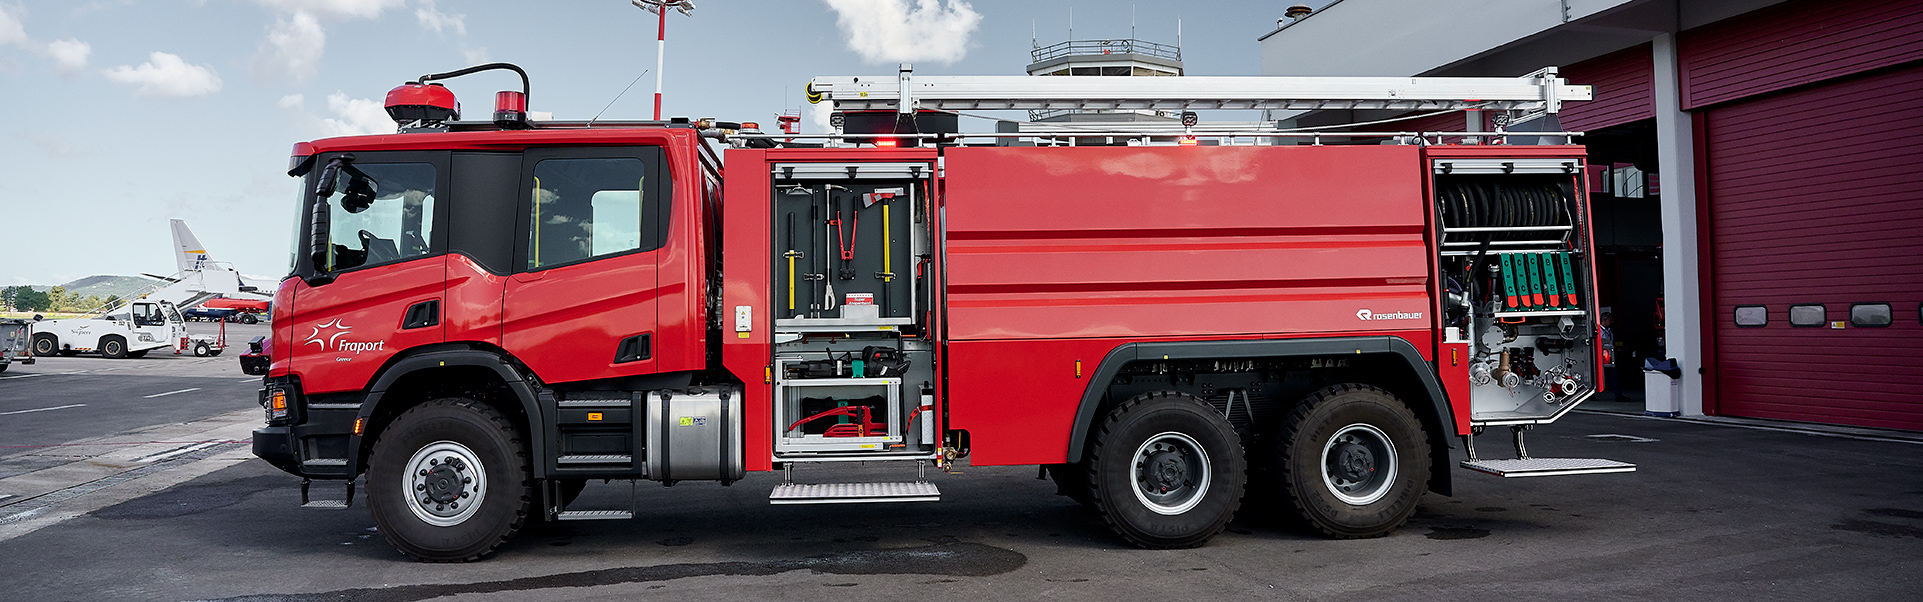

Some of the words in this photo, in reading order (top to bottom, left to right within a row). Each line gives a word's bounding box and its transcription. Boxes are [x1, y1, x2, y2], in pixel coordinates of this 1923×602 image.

[1373, 310, 1423, 321] rosenbauer
[338, 339, 385, 355] Fraport
[1310, 412, 1340, 443] PISTA
[1378, 479, 1415, 519] PIRELLI
